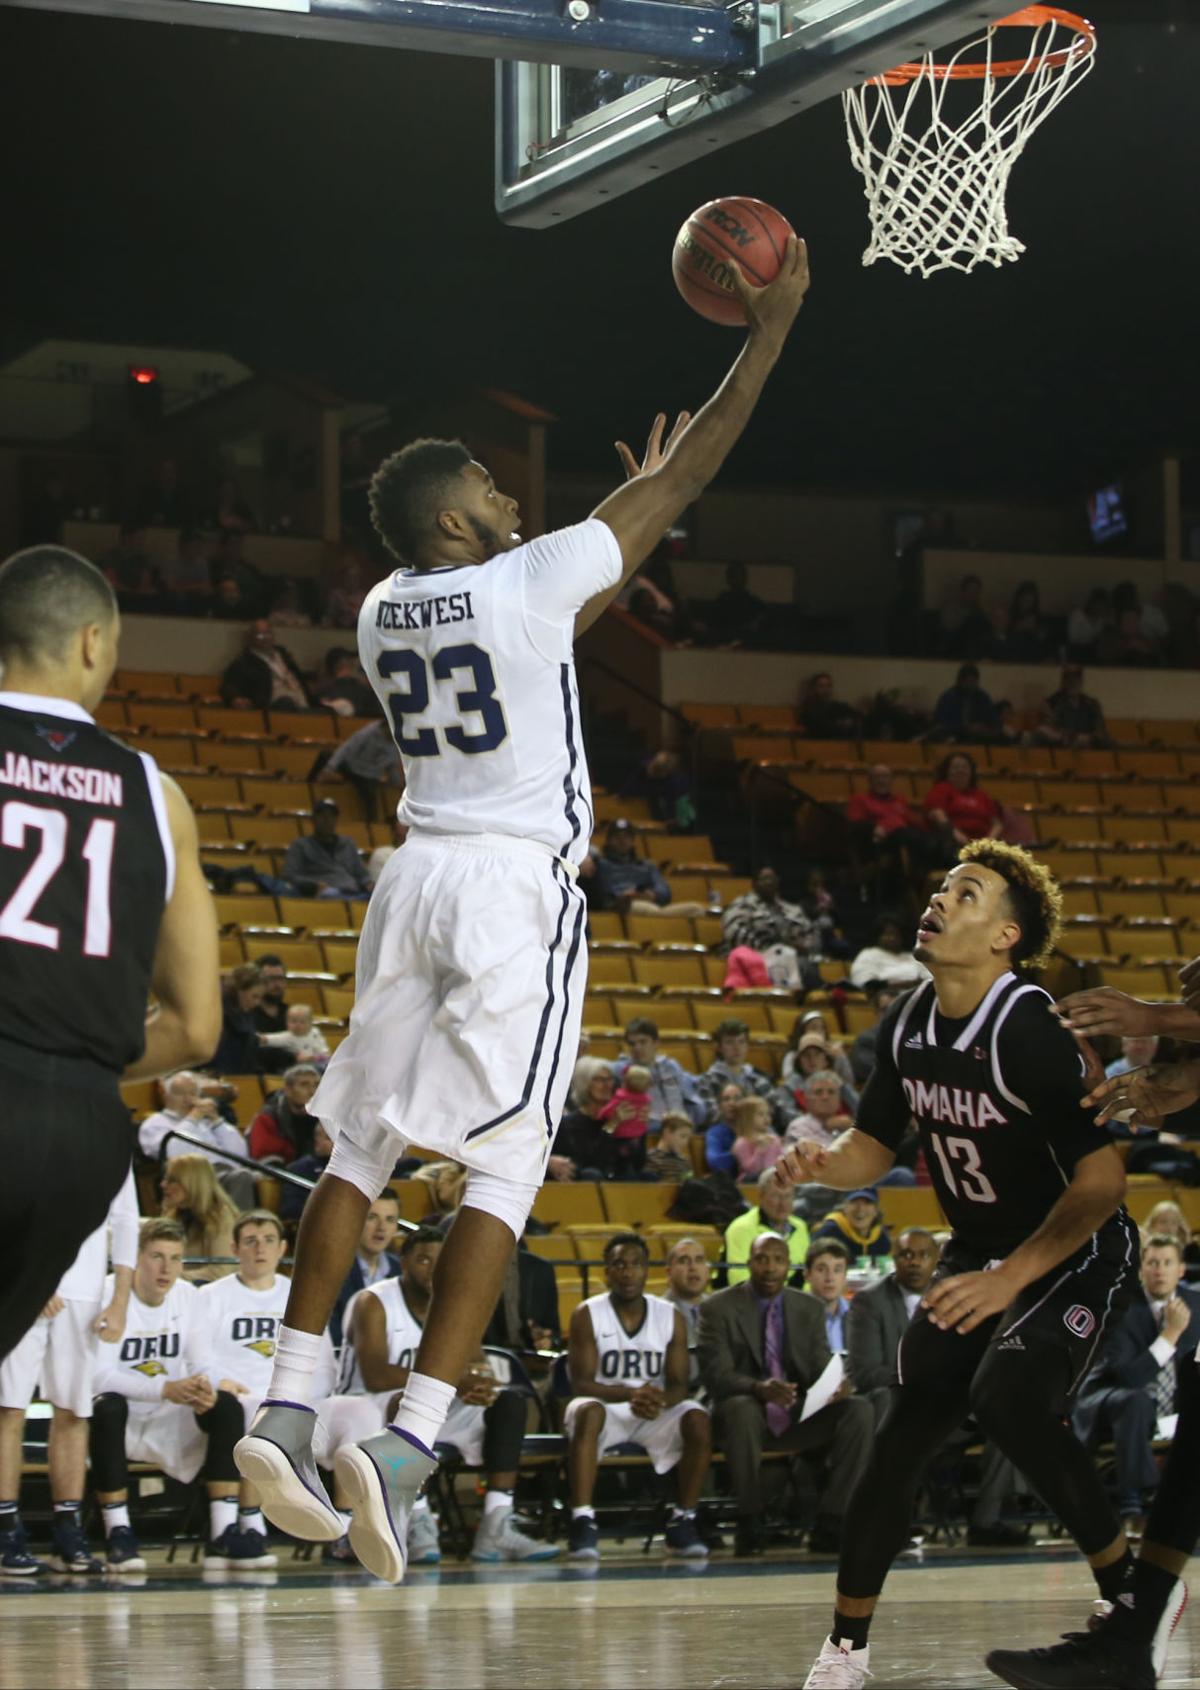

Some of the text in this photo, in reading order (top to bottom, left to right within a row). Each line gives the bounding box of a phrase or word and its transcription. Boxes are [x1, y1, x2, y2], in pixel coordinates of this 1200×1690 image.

[376, 643, 508, 758] 23
[0, 751, 123, 807] JACKSON
[0, 800, 116, 958] 21
[930, 1132, 998, 1204] 13
[231, 1317, 284, 1341] OR
[601, 1348, 663, 1379] ORU
